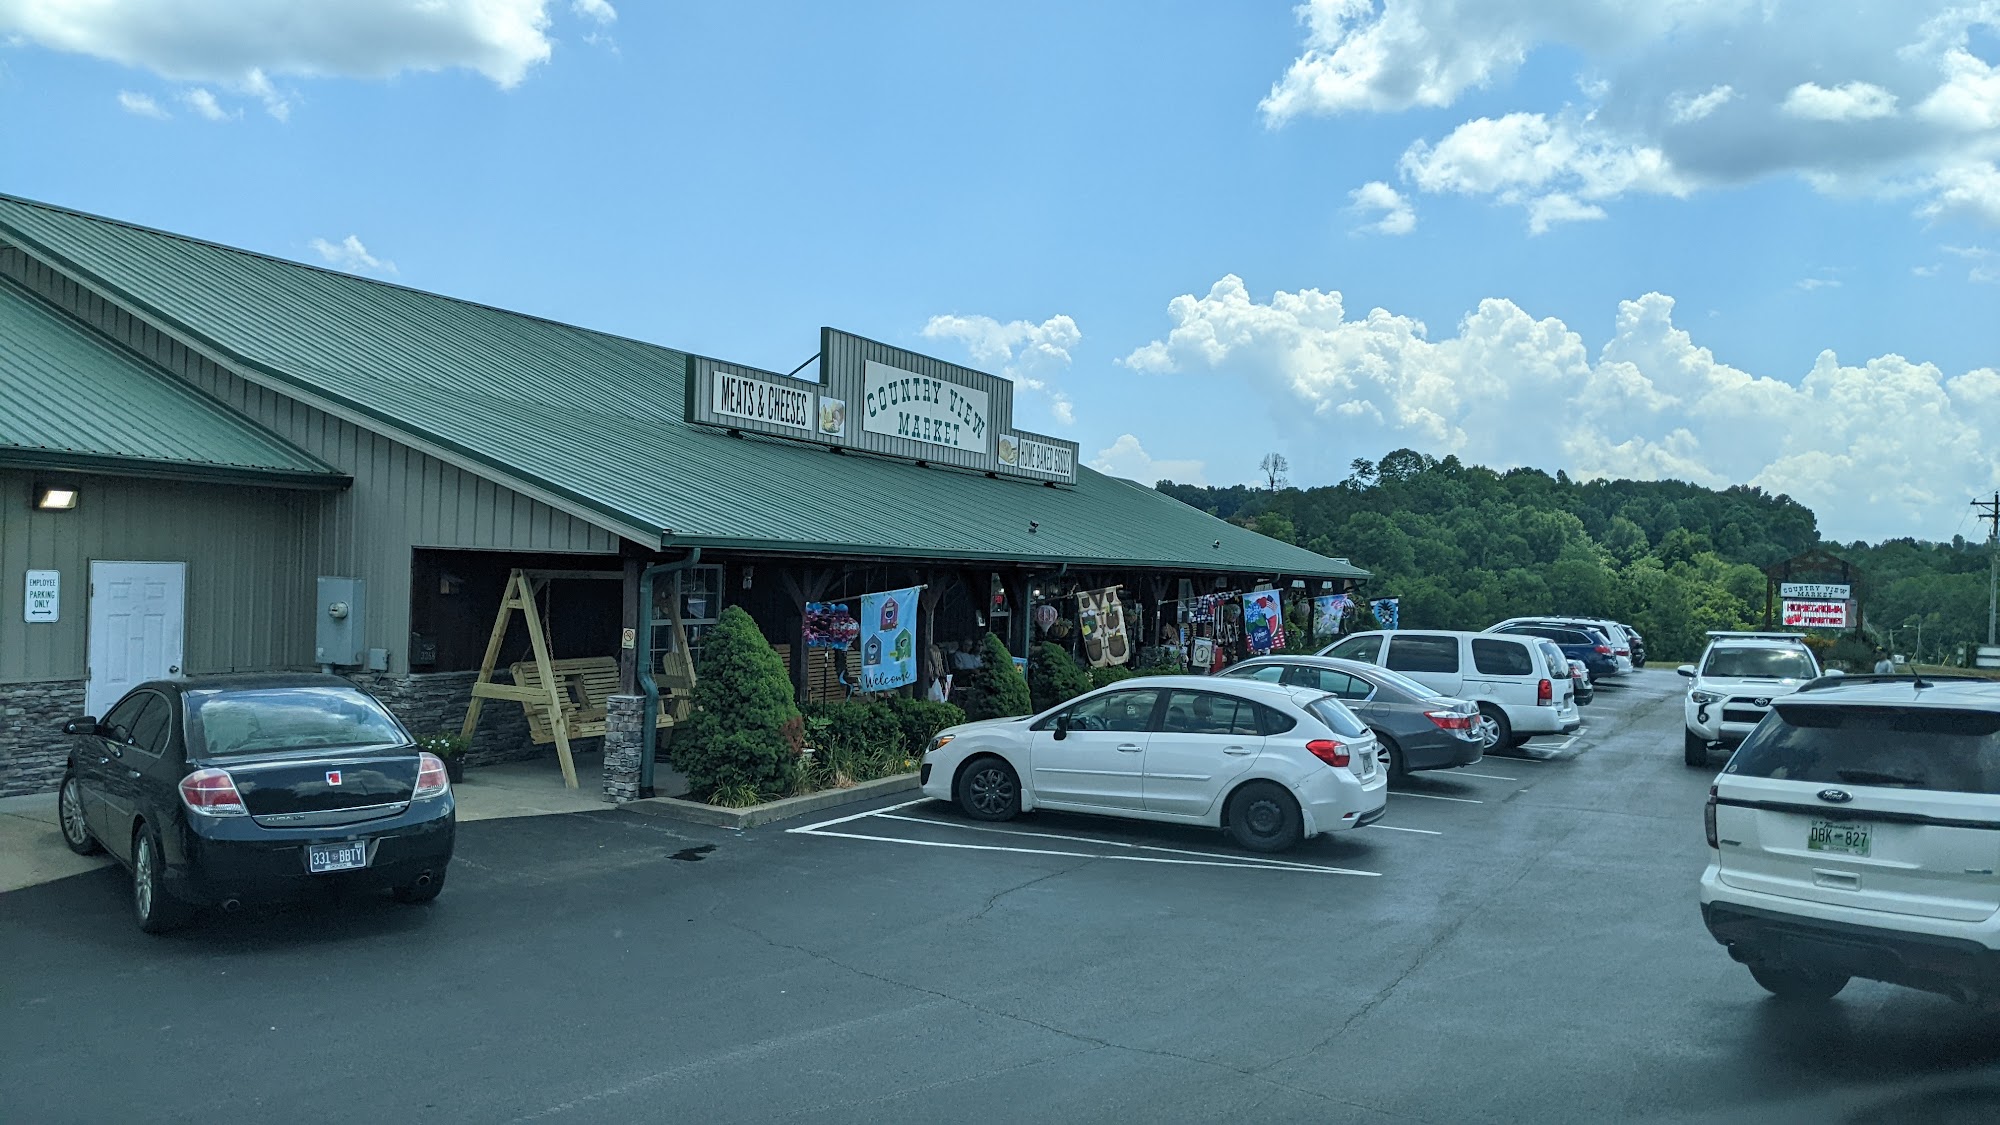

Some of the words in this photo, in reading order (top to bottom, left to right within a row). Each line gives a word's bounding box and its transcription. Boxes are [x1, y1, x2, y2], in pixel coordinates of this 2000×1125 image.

[721, 375, 754, 416] MEATS
[758, 385, 765, 418] &
[768, 386, 807, 426] CHEESES
[866, 377, 942, 417] COUNTRY
[949, 389, 985, 439] VIEW
[898, 411, 960, 446] MARKET
[1020, 441, 1036, 468] HOME
[1036, 444, 1053, 470] BAKED
[1054, 448, 1070, 475] GOODS
[29, 579, 56, 587] EMPLOYEE
[1783, 585, 1820, 594] COUNTRY
[1825, 586, 1848, 595] VIEW
[29, 590, 55, 599] PARKING
[34, 599, 50, 608] ONLY
[863, 671, 911, 689] Welcome
[1822, 790, 1844, 800] Ford
[1811, 827, 1832, 843] DBK
[1845, 831, 1867, 847] 827
[313, 852, 331, 865] 331
[339, 848, 362, 863] BBTY
